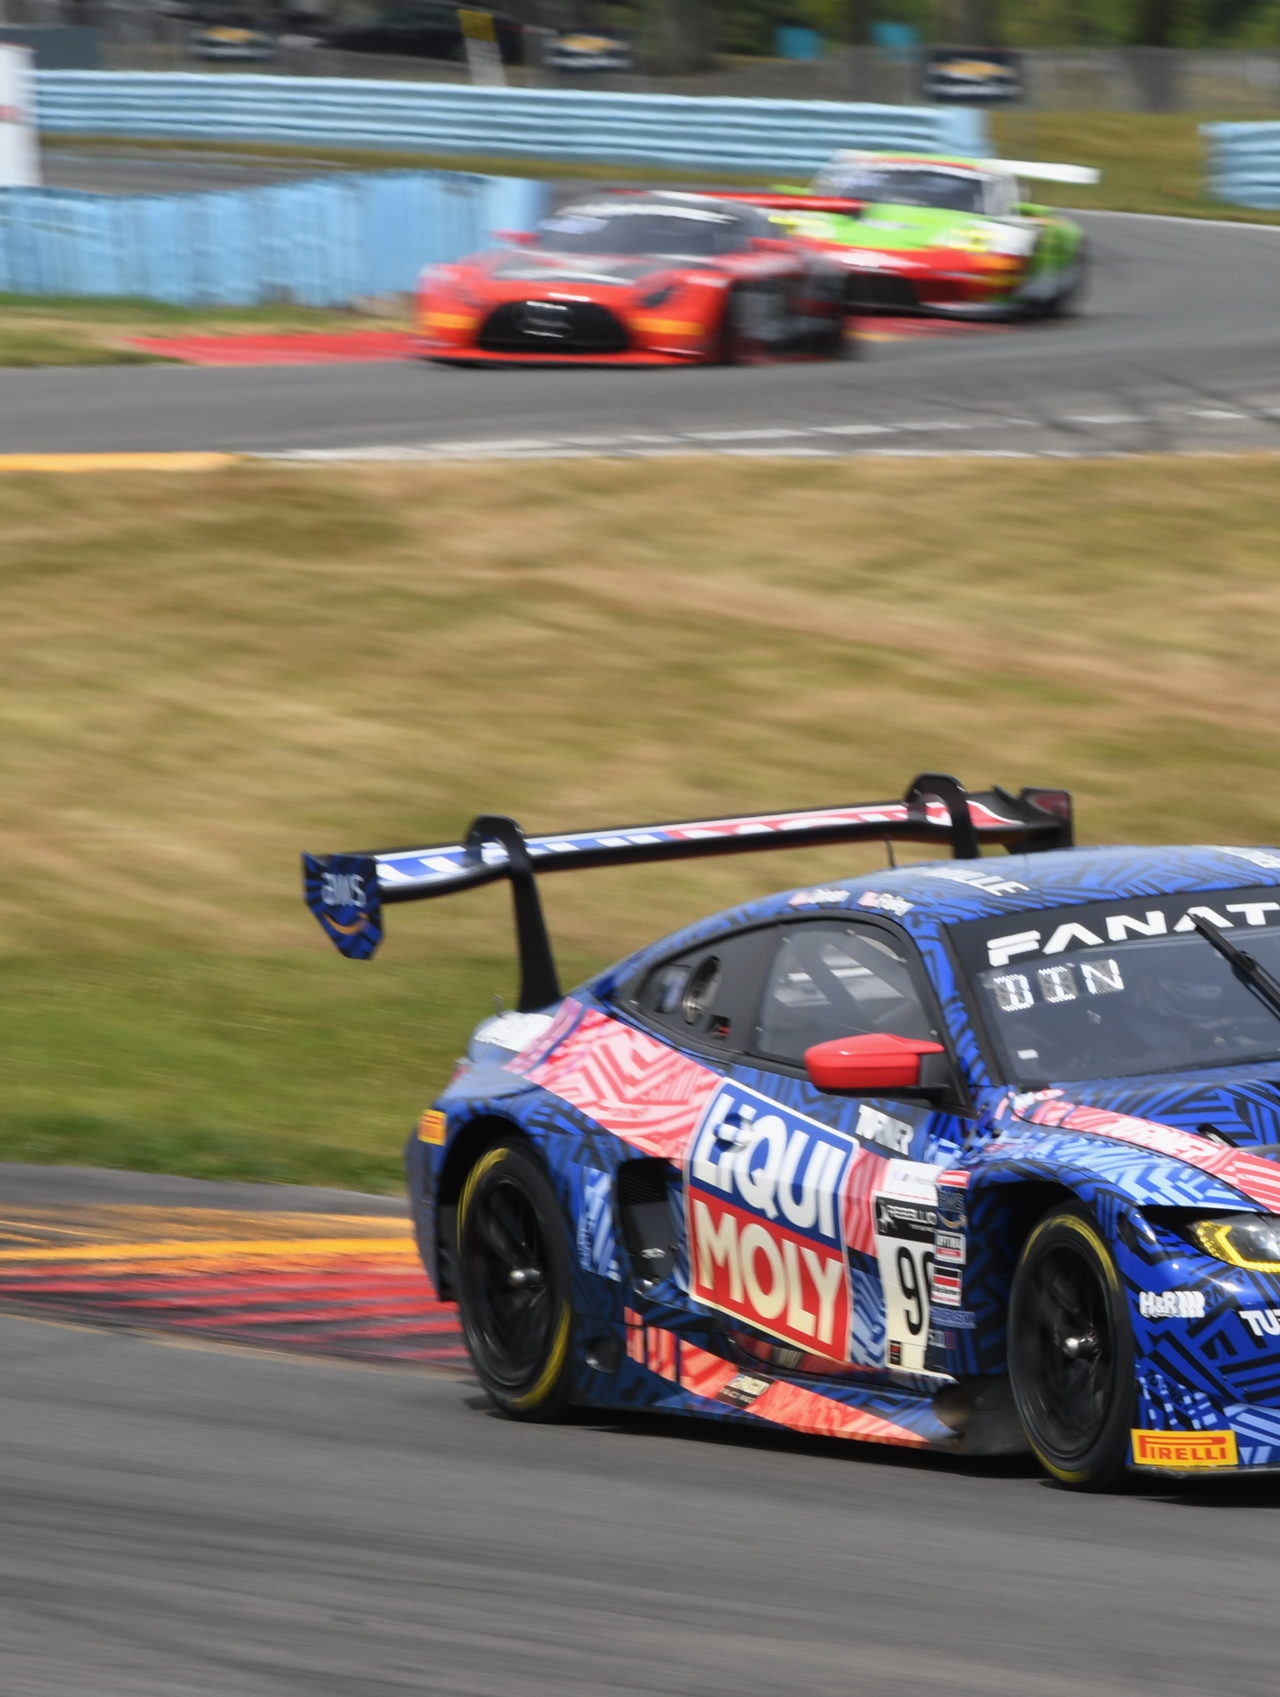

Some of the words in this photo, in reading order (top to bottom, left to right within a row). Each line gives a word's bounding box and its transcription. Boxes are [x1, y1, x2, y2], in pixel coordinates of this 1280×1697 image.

[994, 958, 1125, 1013] DIN
[693, 1199, 845, 1346] MOLY
[1138, 1434, 1228, 1461] PIRELLI
